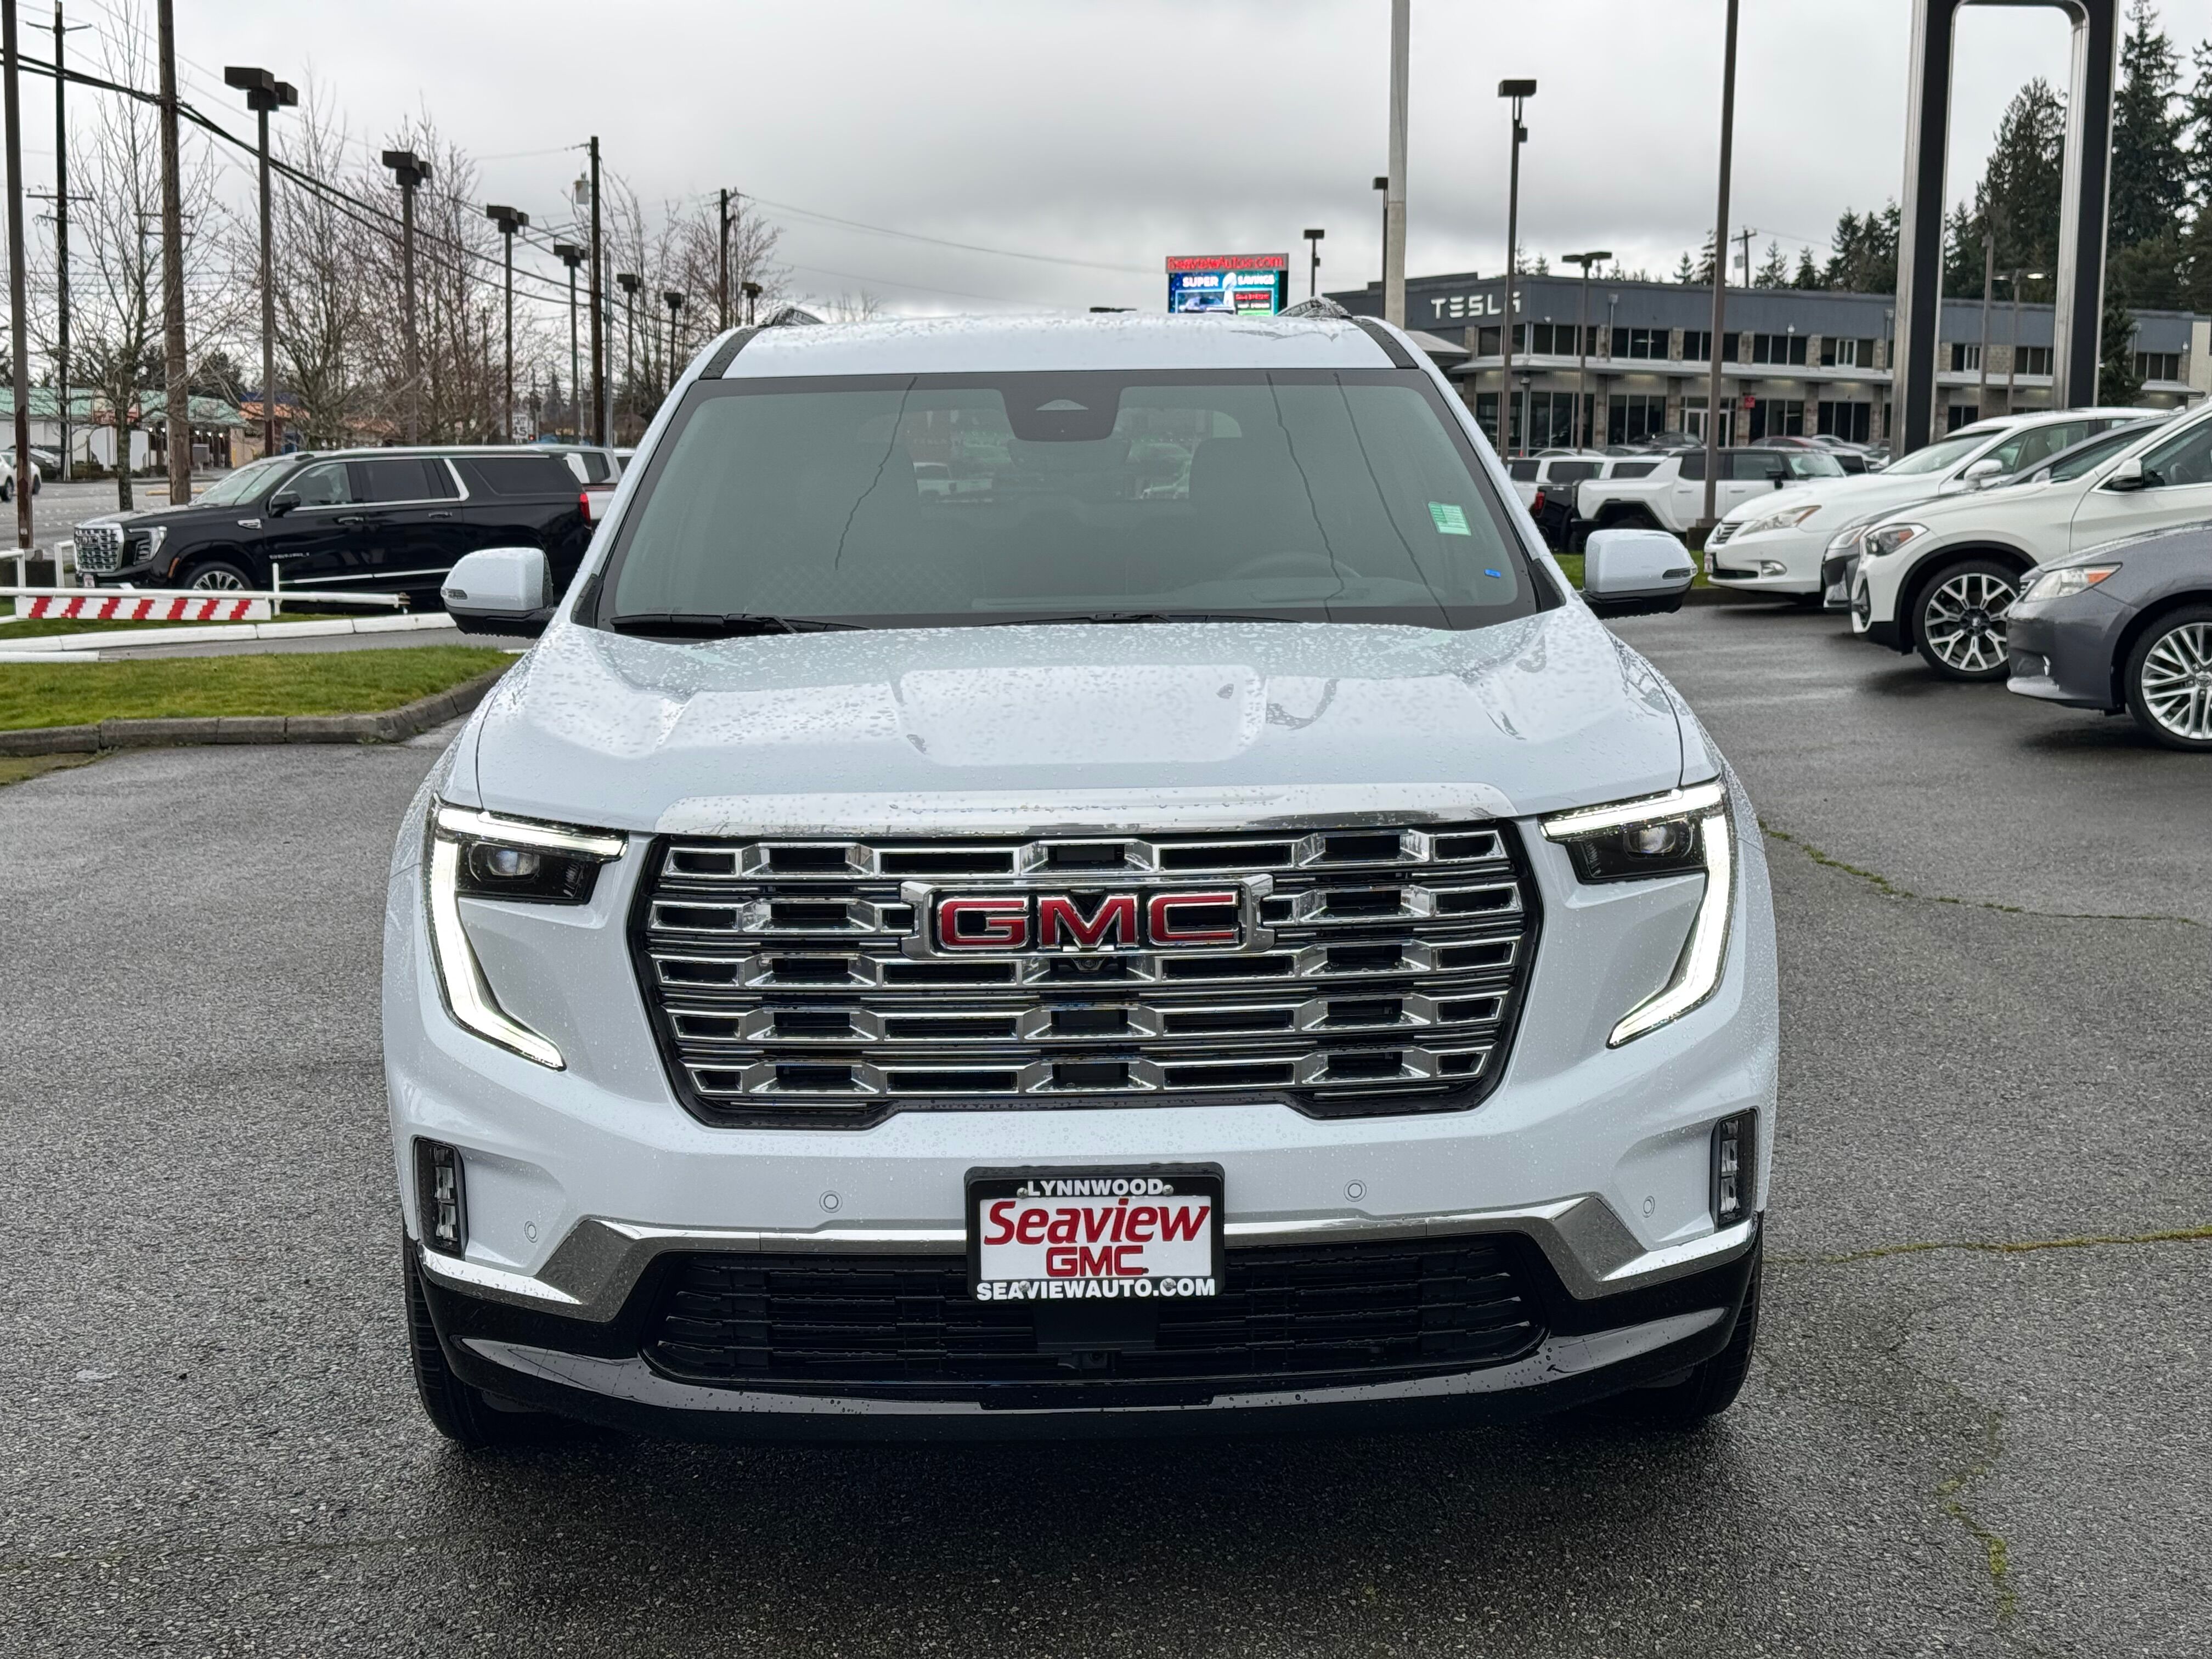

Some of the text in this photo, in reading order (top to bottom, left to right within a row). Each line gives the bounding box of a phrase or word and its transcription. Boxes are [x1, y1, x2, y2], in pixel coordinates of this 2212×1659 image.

[1182, 274, 1275, 287] SUPER SAVINGS
[938, 891, 1239, 951] GMC
[1027, 1178, 1163, 1197] LYNNWOOD
[984, 1198, 1210, 1245] Seaview
[1046, 1245, 1144, 1277] GMC
[977, 1278, 1215, 1301] SEAVIEWAUTO.COM
